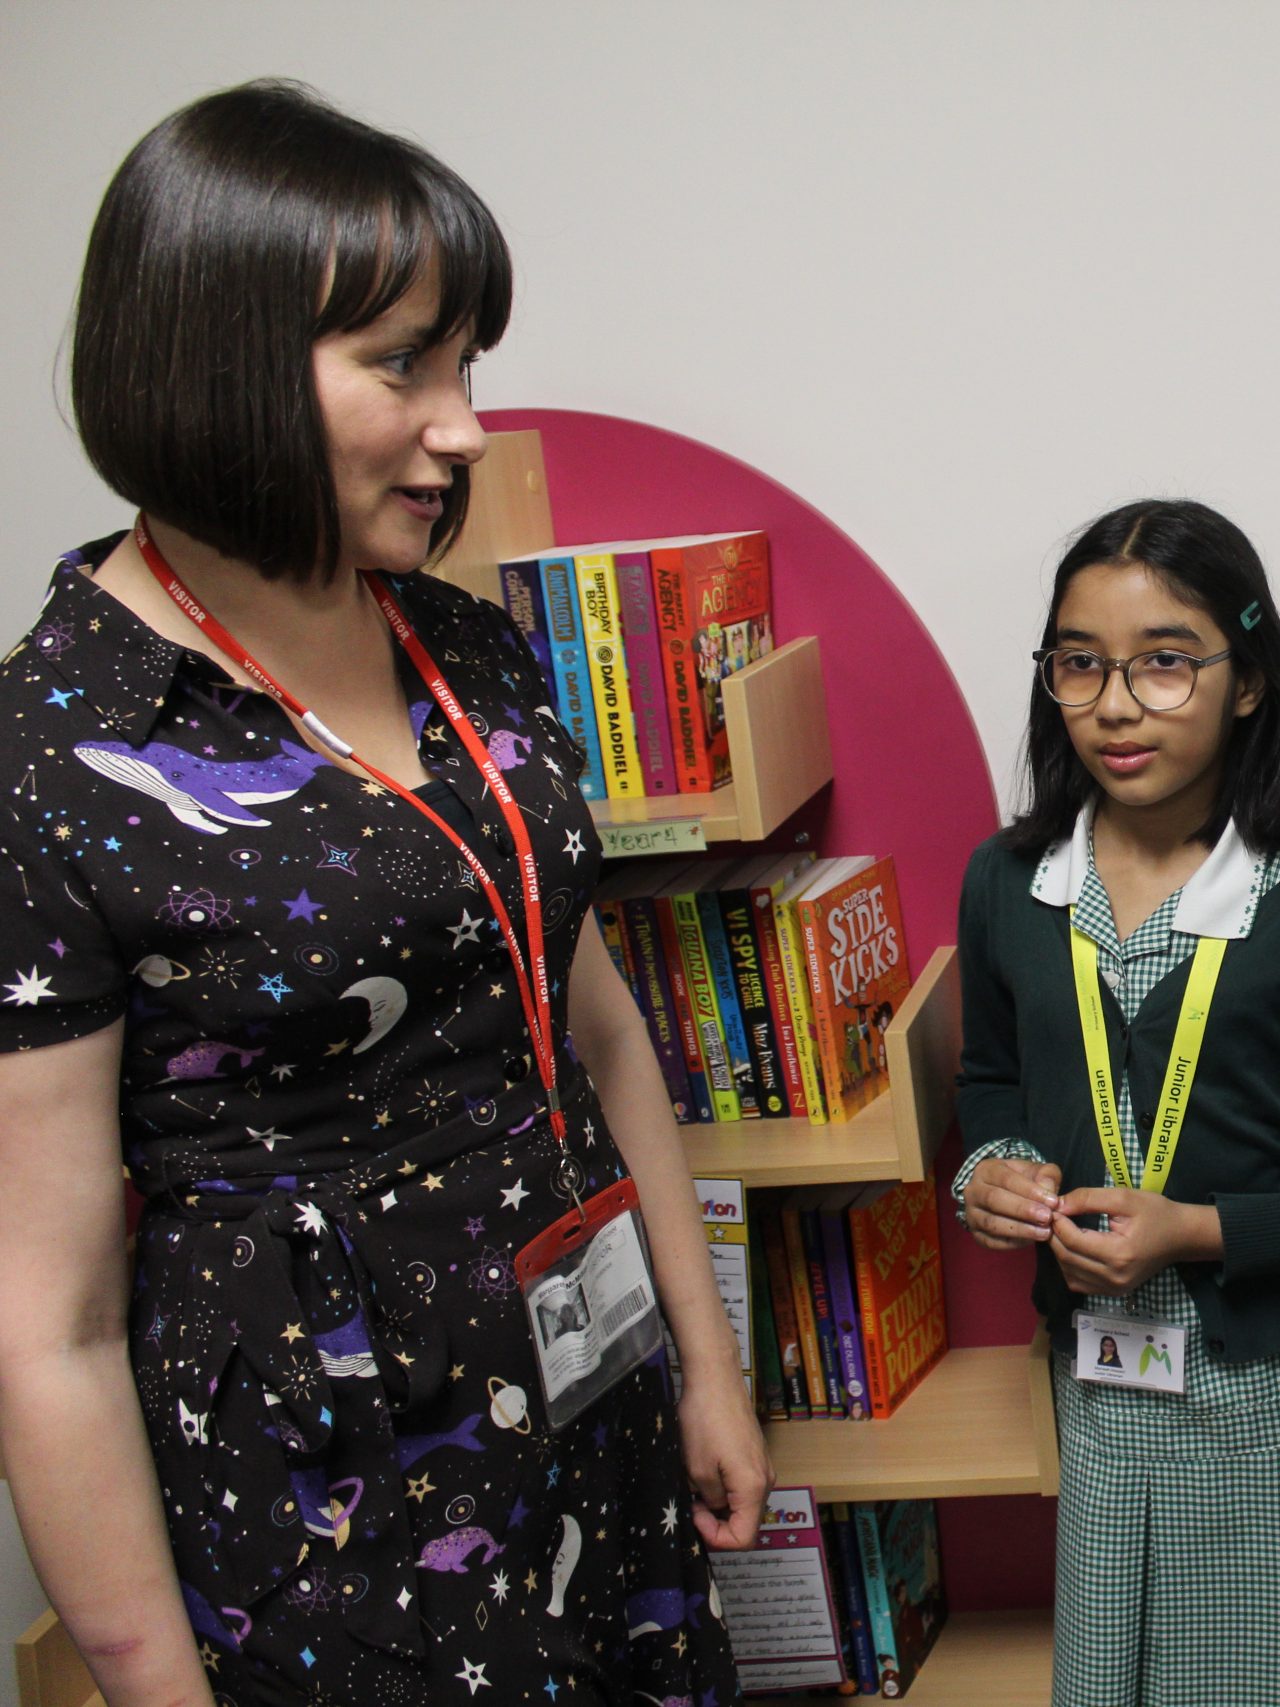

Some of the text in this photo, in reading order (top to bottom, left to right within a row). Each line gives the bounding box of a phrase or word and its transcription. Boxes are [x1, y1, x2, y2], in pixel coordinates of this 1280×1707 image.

[167, 580, 207, 624] VISITOR
[380, 599, 411, 642] VISITOR
[519, 586, 534, 632] PERSON
[585, 589, 598, 619] BOY
[594, 572, 611, 634] BIRTHDAY
[655, 567, 677, 633] AGENCY
[242, 659, 284, 700] VISITOR
[429, 679, 465, 722] VISITOR
[564, 671, 579, 712] DAVID
[600, 664, 627, 776] DAVID BADDIEL
[672, 660, 698, 769] DAVID BADDIEL
[641, 708, 661, 773] BADDIEL
[482, 760, 514, 804] VISITOR
[604, 827, 662, 852] Year
[459, 842, 492, 885] VISITOR
[523, 853, 540, 903] VISITOR
[828, 884, 888, 958] SIDE
[842, 888, 869, 914] SUPER
[508, 926, 526, 973] VISITOR
[681, 926, 705, 981] IGUANA
[724, 908, 758, 971] VI SPY
[802, 926, 815, 952] SUPER
[536, 955, 550, 1004] VISITOR
[770, 962, 781, 981] Club
[807, 953, 821, 994] SIDEKICKS
[829, 926, 899, 1006] KICKS
[692, 983, 713, 1017] BOY
[737, 973, 754, 1010] TO CHILL
[747, 972, 765, 1008] LICENCE
[673, 973, 685, 996] BOOK
[682, 1020, 696, 1056] THINGS
[752, 1022, 770, 1048] Maz
[758, 1049, 777, 1089] Evans
[1095, 1069, 1115, 1138] Librarian
[1151, 1056, 1193, 1174] Junior Librarian
[879, 1258, 940, 1352] FUNNY
[885, 1300, 944, 1396] POEMS
